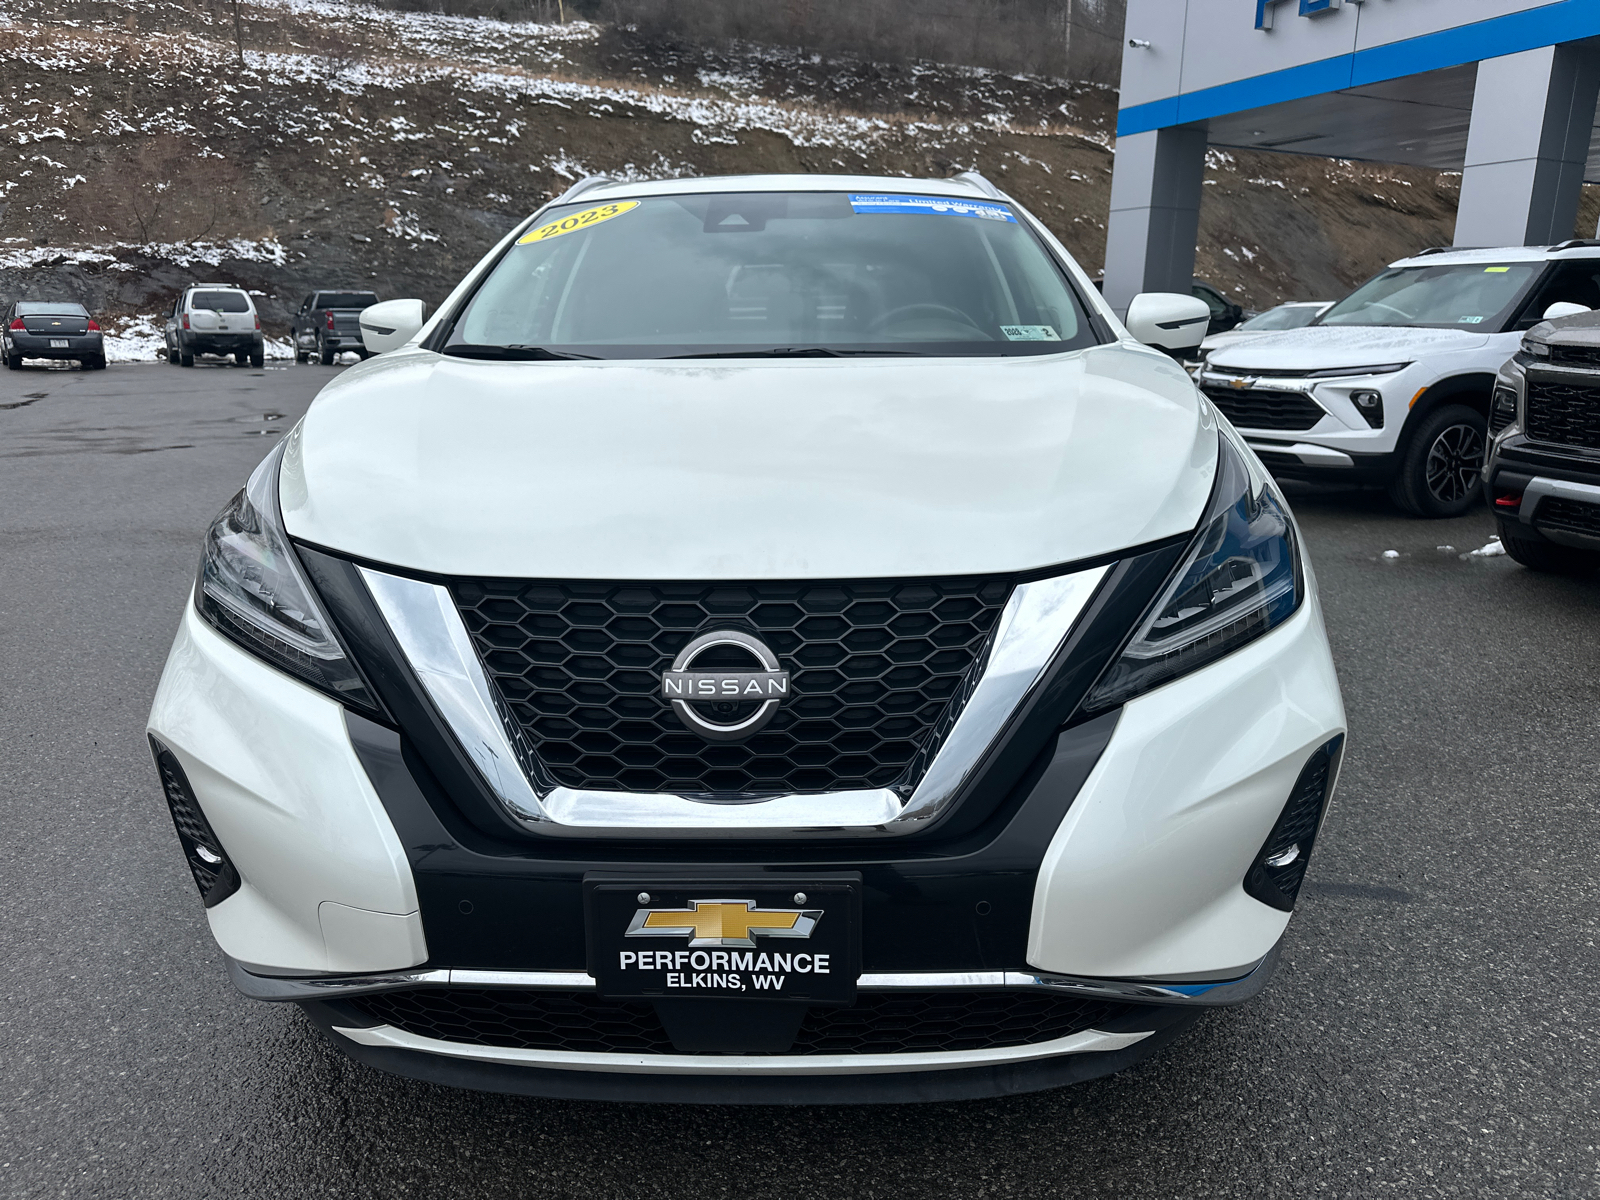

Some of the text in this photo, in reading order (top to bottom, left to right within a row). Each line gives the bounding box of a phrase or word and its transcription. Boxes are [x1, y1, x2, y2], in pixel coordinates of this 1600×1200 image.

[909, 198, 1002, 213] Limited Warranty
[541, 204, 619, 239] 2023
[1042, 327, 1053, 337] 2
[665, 678, 787, 695] NISSAN
[619, 950, 831, 974] PERFORMANCE
[666, 972, 786, 992] ELKINS, WV
